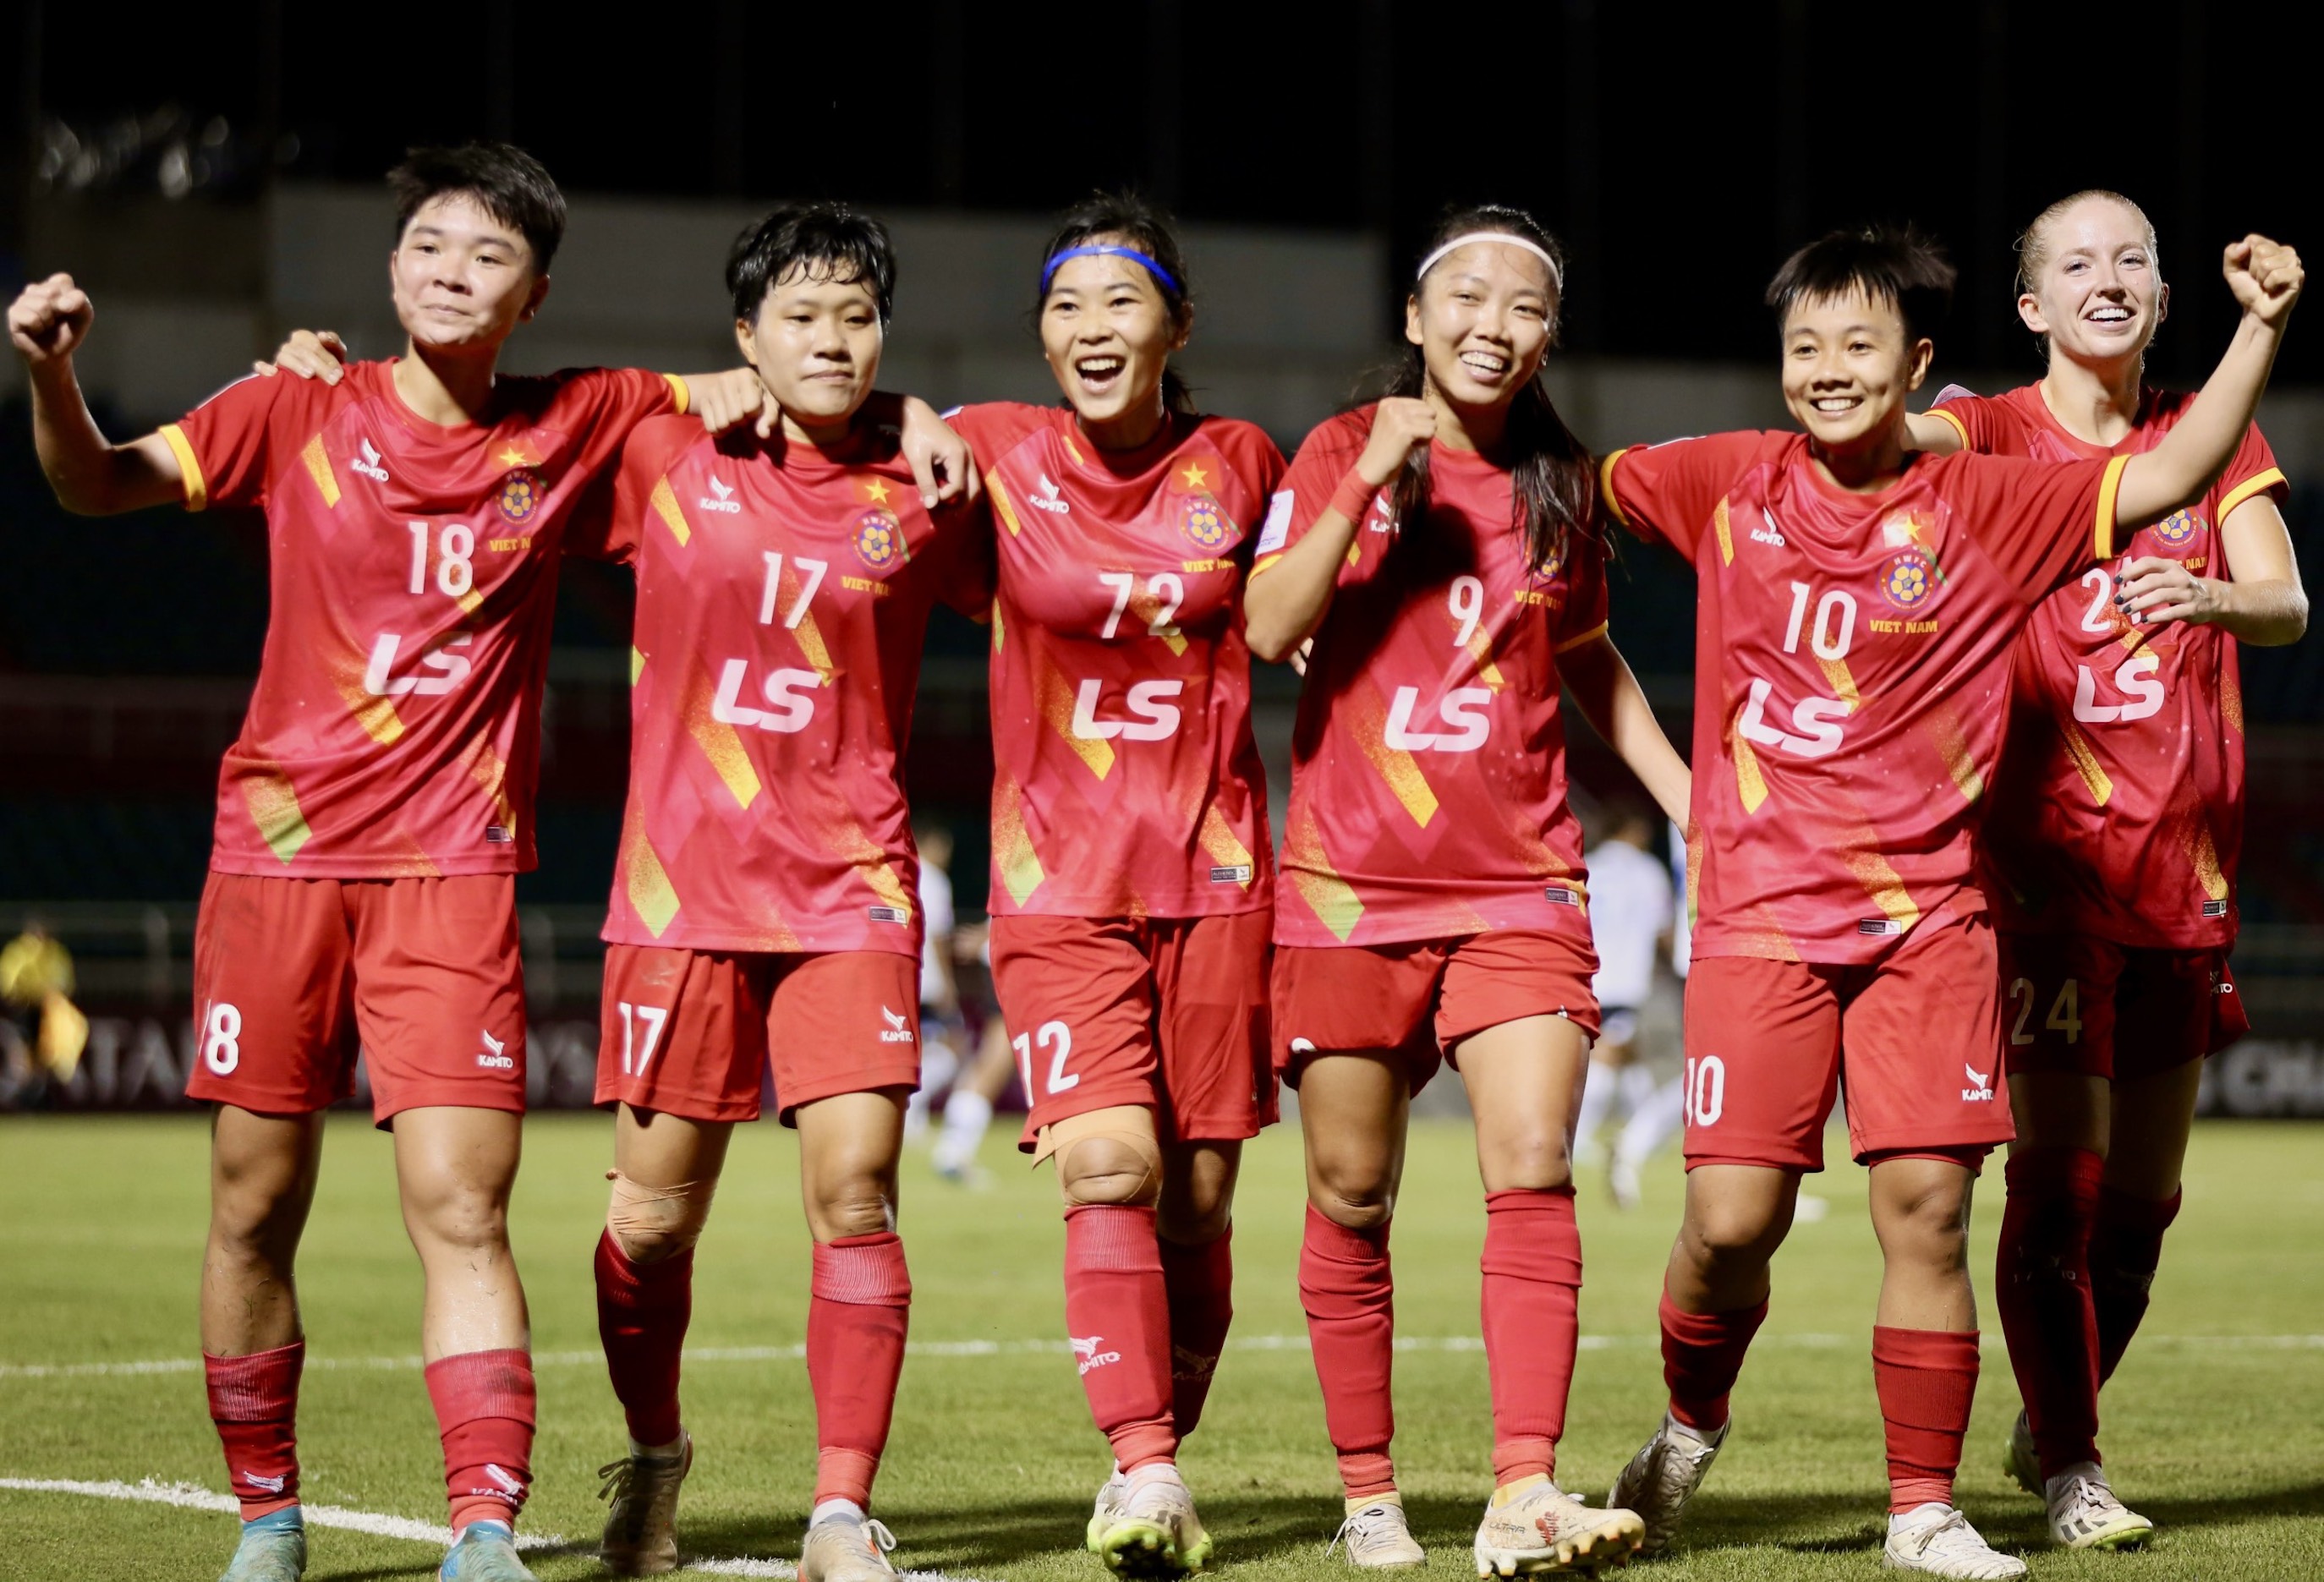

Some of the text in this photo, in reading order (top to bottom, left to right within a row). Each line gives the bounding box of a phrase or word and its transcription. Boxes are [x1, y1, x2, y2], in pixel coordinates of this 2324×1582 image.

[408, 521, 474, 596] 18
[490, 539, 518, 551] VIET
[1182, 560, 1214, 572] VIET
[760, 551, 828, 629] 17
[841, 576, 872, 592] VIET
[1099, 572, 1184, 639] 72
[1449, 575, 1484, 647] 9
[1783, 581, 1857, 660] 10
[1870, 619, 1938, 633] VIET NAM
[364, 632, 472, 696] LS
[711, 659, 825, 733] LS
[2072, 654, 2165, 723] LS
[1072, 679, 1184, 741] LS
[1384, 687, 1491, 752] LS
[1737, 678, 1853, 758] LS
[619, 1002, 667, 1077] 17
[2009, 977, 2082, 1045] 24
[479, 1054, 513, 1069] KAMITO
